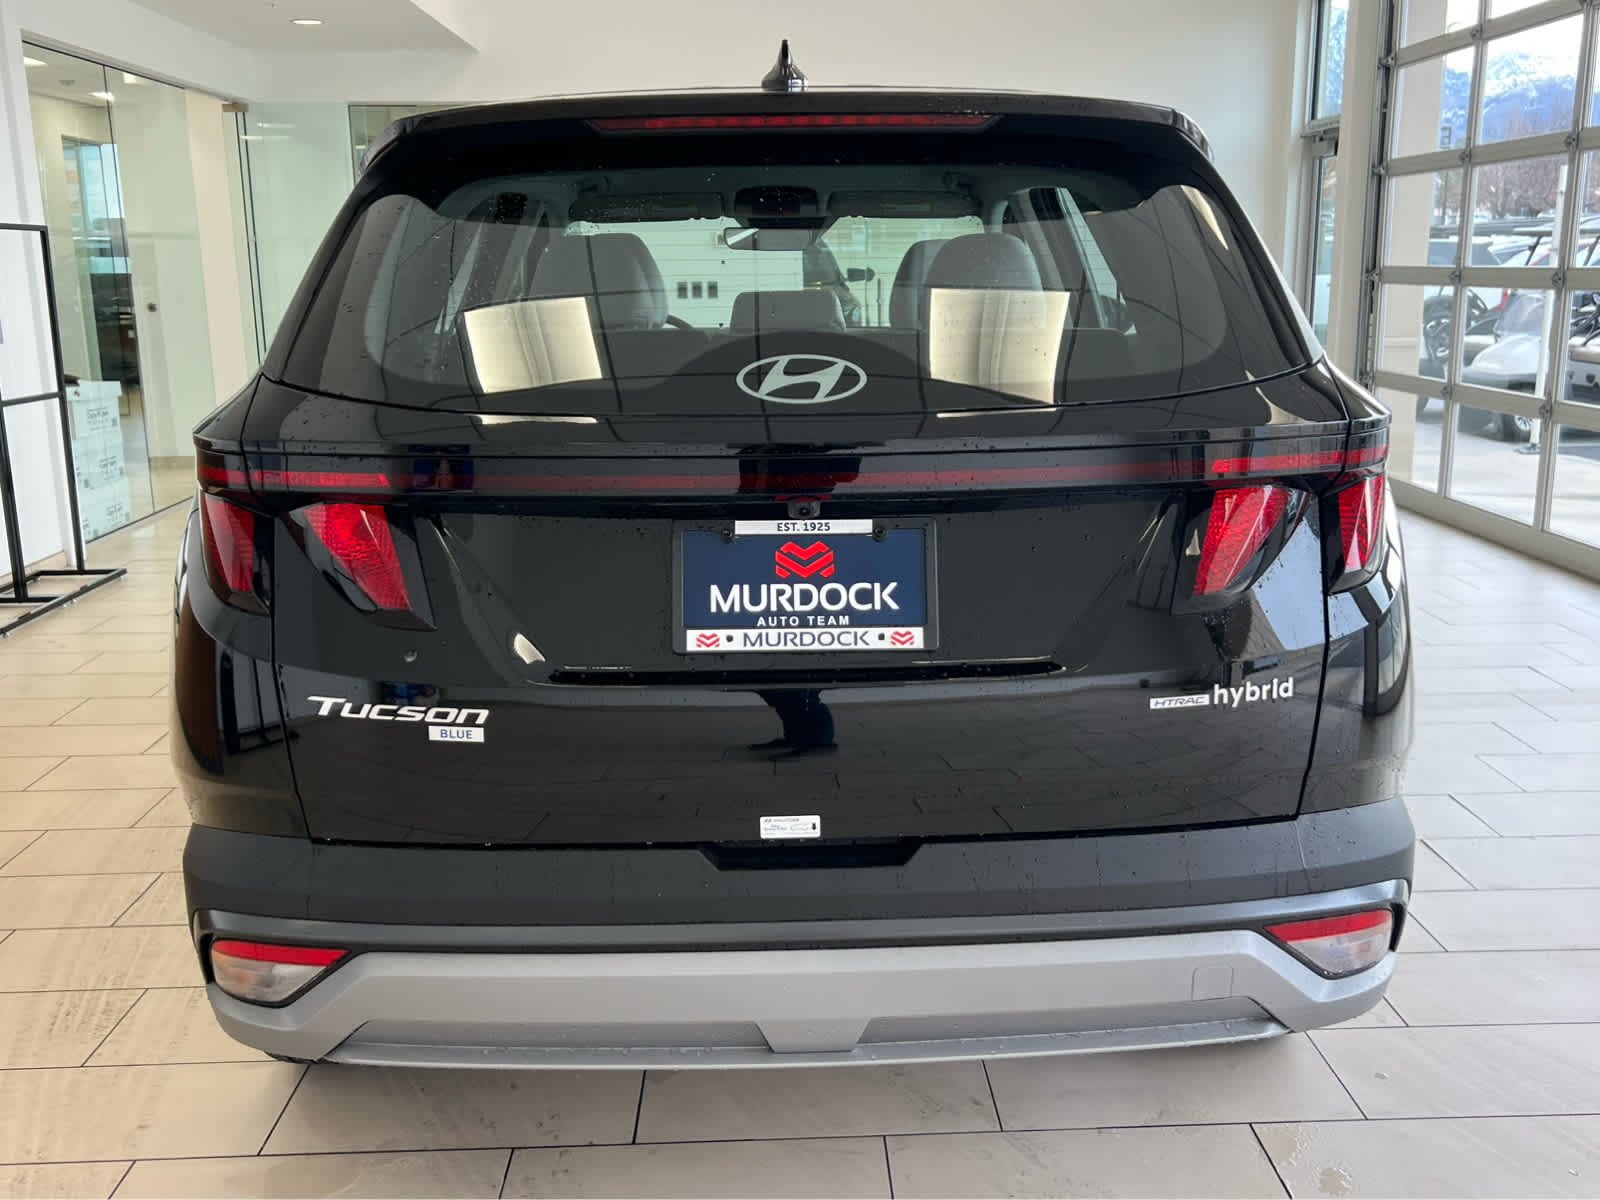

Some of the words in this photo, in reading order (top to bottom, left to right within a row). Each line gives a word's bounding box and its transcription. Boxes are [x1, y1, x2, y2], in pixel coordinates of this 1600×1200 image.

[777, 522, 799, 532] EST.
[803, 521, 831, 532] 1925
[710, 582, 900, 613] MURDOCK
[757, 616, 799, 627] AUTO
[807, 615, 850, 626] TEAM
[743, 631, 871, 648] MURDOCK
[1153, 697, 1206, 708] HTRAC
[1213, 676, 1294, 708] hybrid
[440, 728, 473, 740] BLUE
